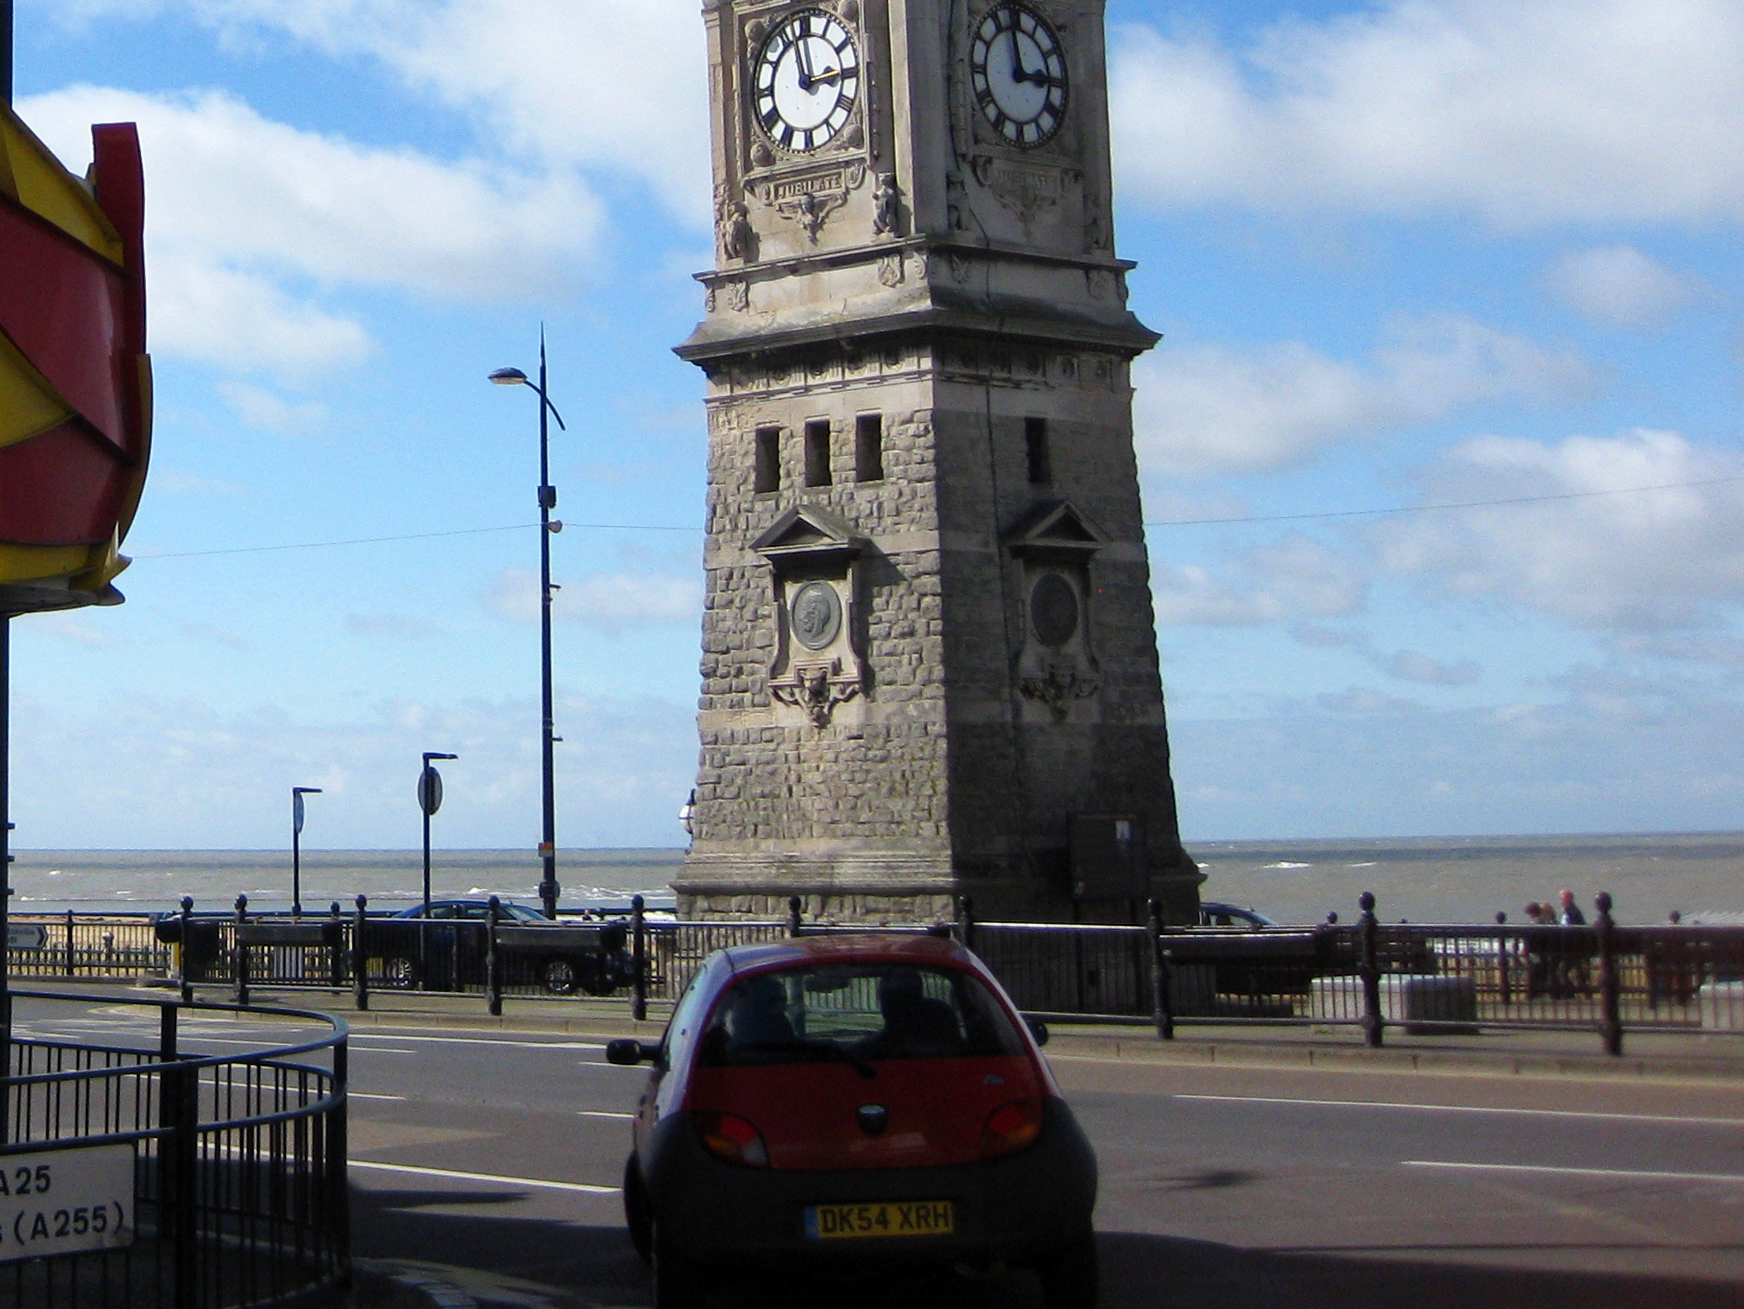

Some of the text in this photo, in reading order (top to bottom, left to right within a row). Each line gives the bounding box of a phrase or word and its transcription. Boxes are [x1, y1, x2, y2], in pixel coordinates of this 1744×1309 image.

[13, 1200, 125, 1246] (A255)
[819, 1203, 951, 1233] DK54 XRH
